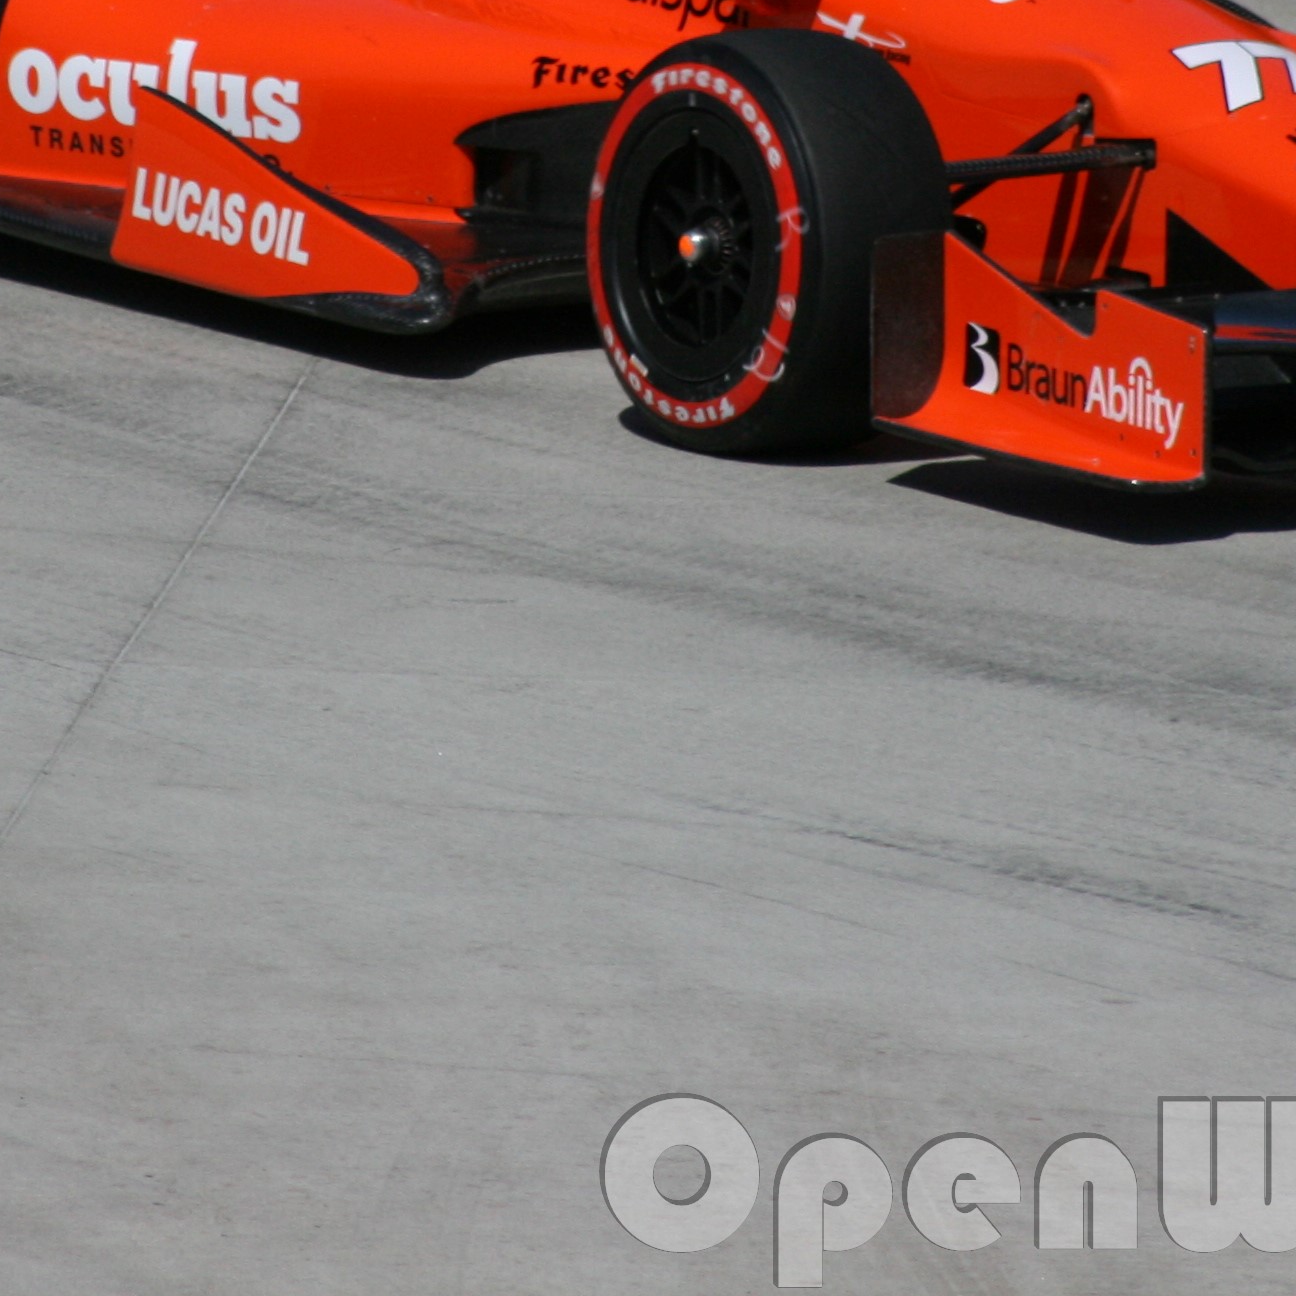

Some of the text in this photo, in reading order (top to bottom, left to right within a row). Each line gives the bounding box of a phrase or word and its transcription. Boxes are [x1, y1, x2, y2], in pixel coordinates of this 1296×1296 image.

[532, 56, 635, 91] Fires
[650, 67, 783, 170] Firestone
[30, 124, 134, 158] TRANS
[131, 167, 310, 267] LUCAS OIL
[603, 324, 736, 426] Firestone
[1007, 342, 1184, 450] BraunAbility
